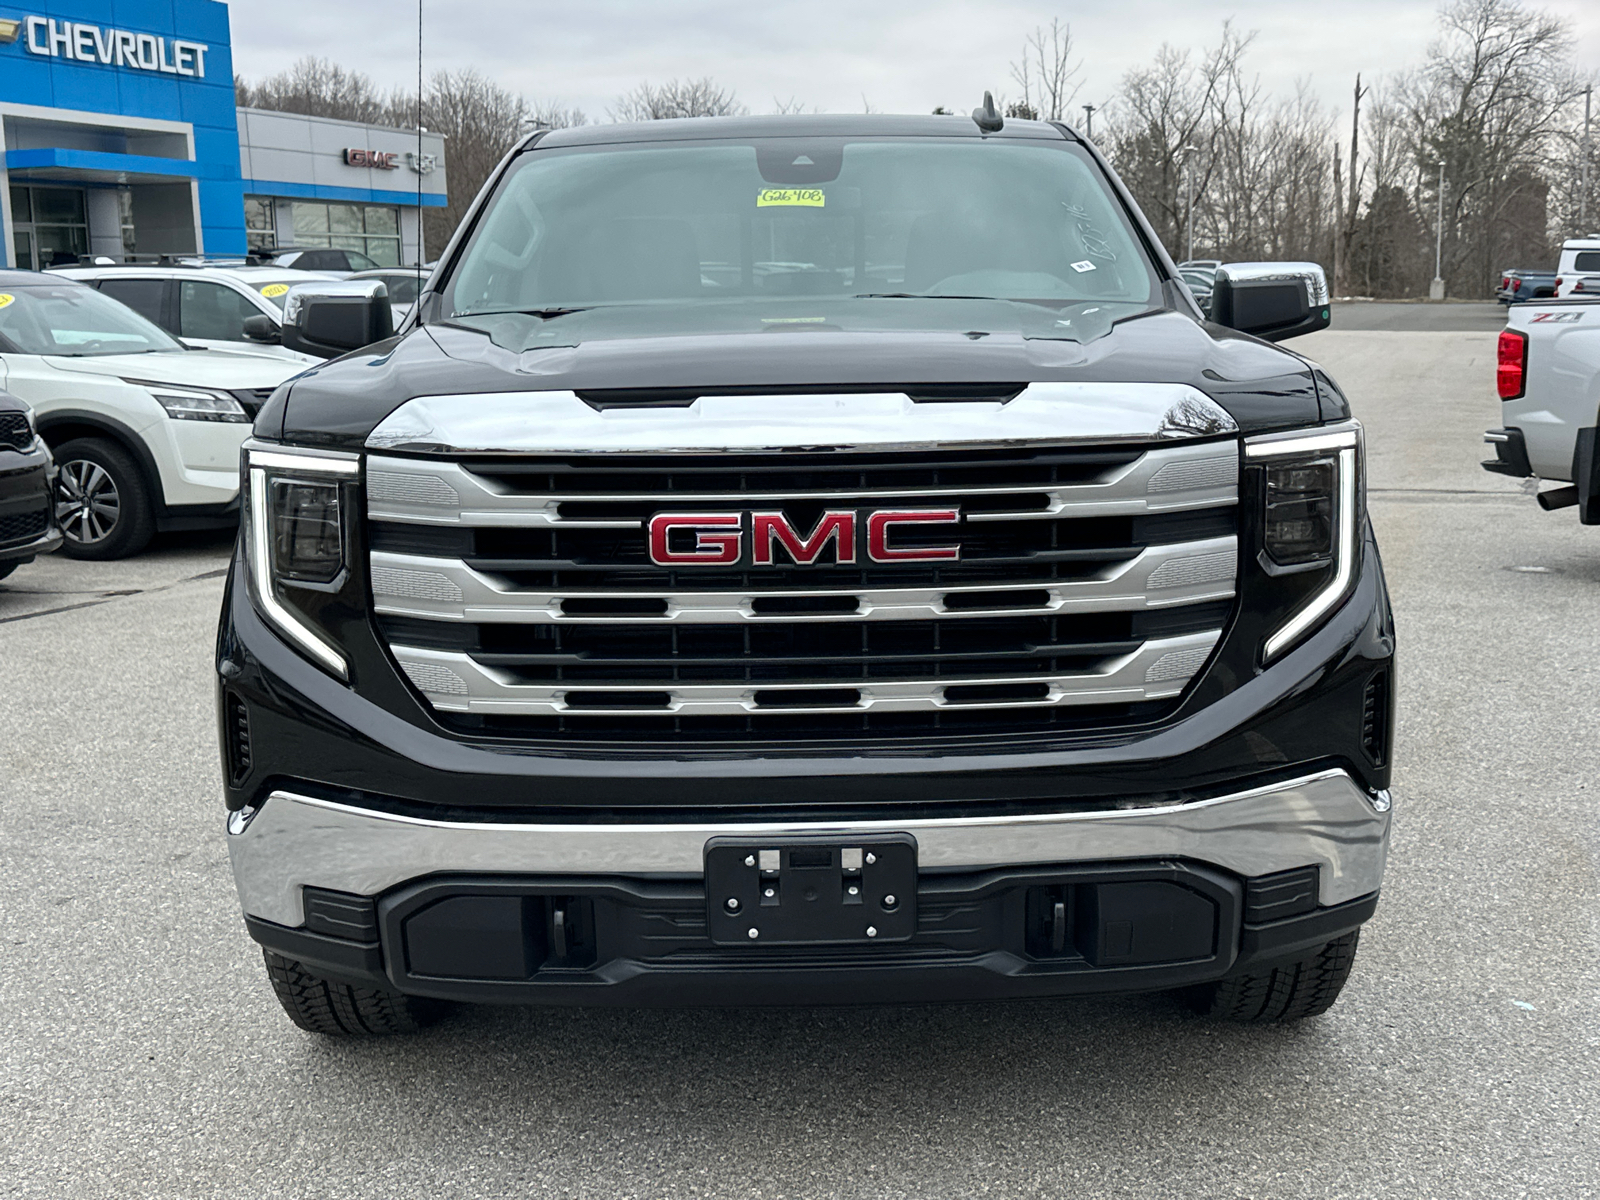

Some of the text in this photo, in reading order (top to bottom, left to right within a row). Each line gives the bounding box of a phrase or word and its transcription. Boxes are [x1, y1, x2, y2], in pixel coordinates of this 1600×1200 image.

[26, 15, 208, 78] CHEVROLET
[345, 148, 399, 170] GMC
[762, 190, 822, 202] G26-408
[1528, 312, 1586, 324] Z71
[649, 508, 961, 567] GMC
